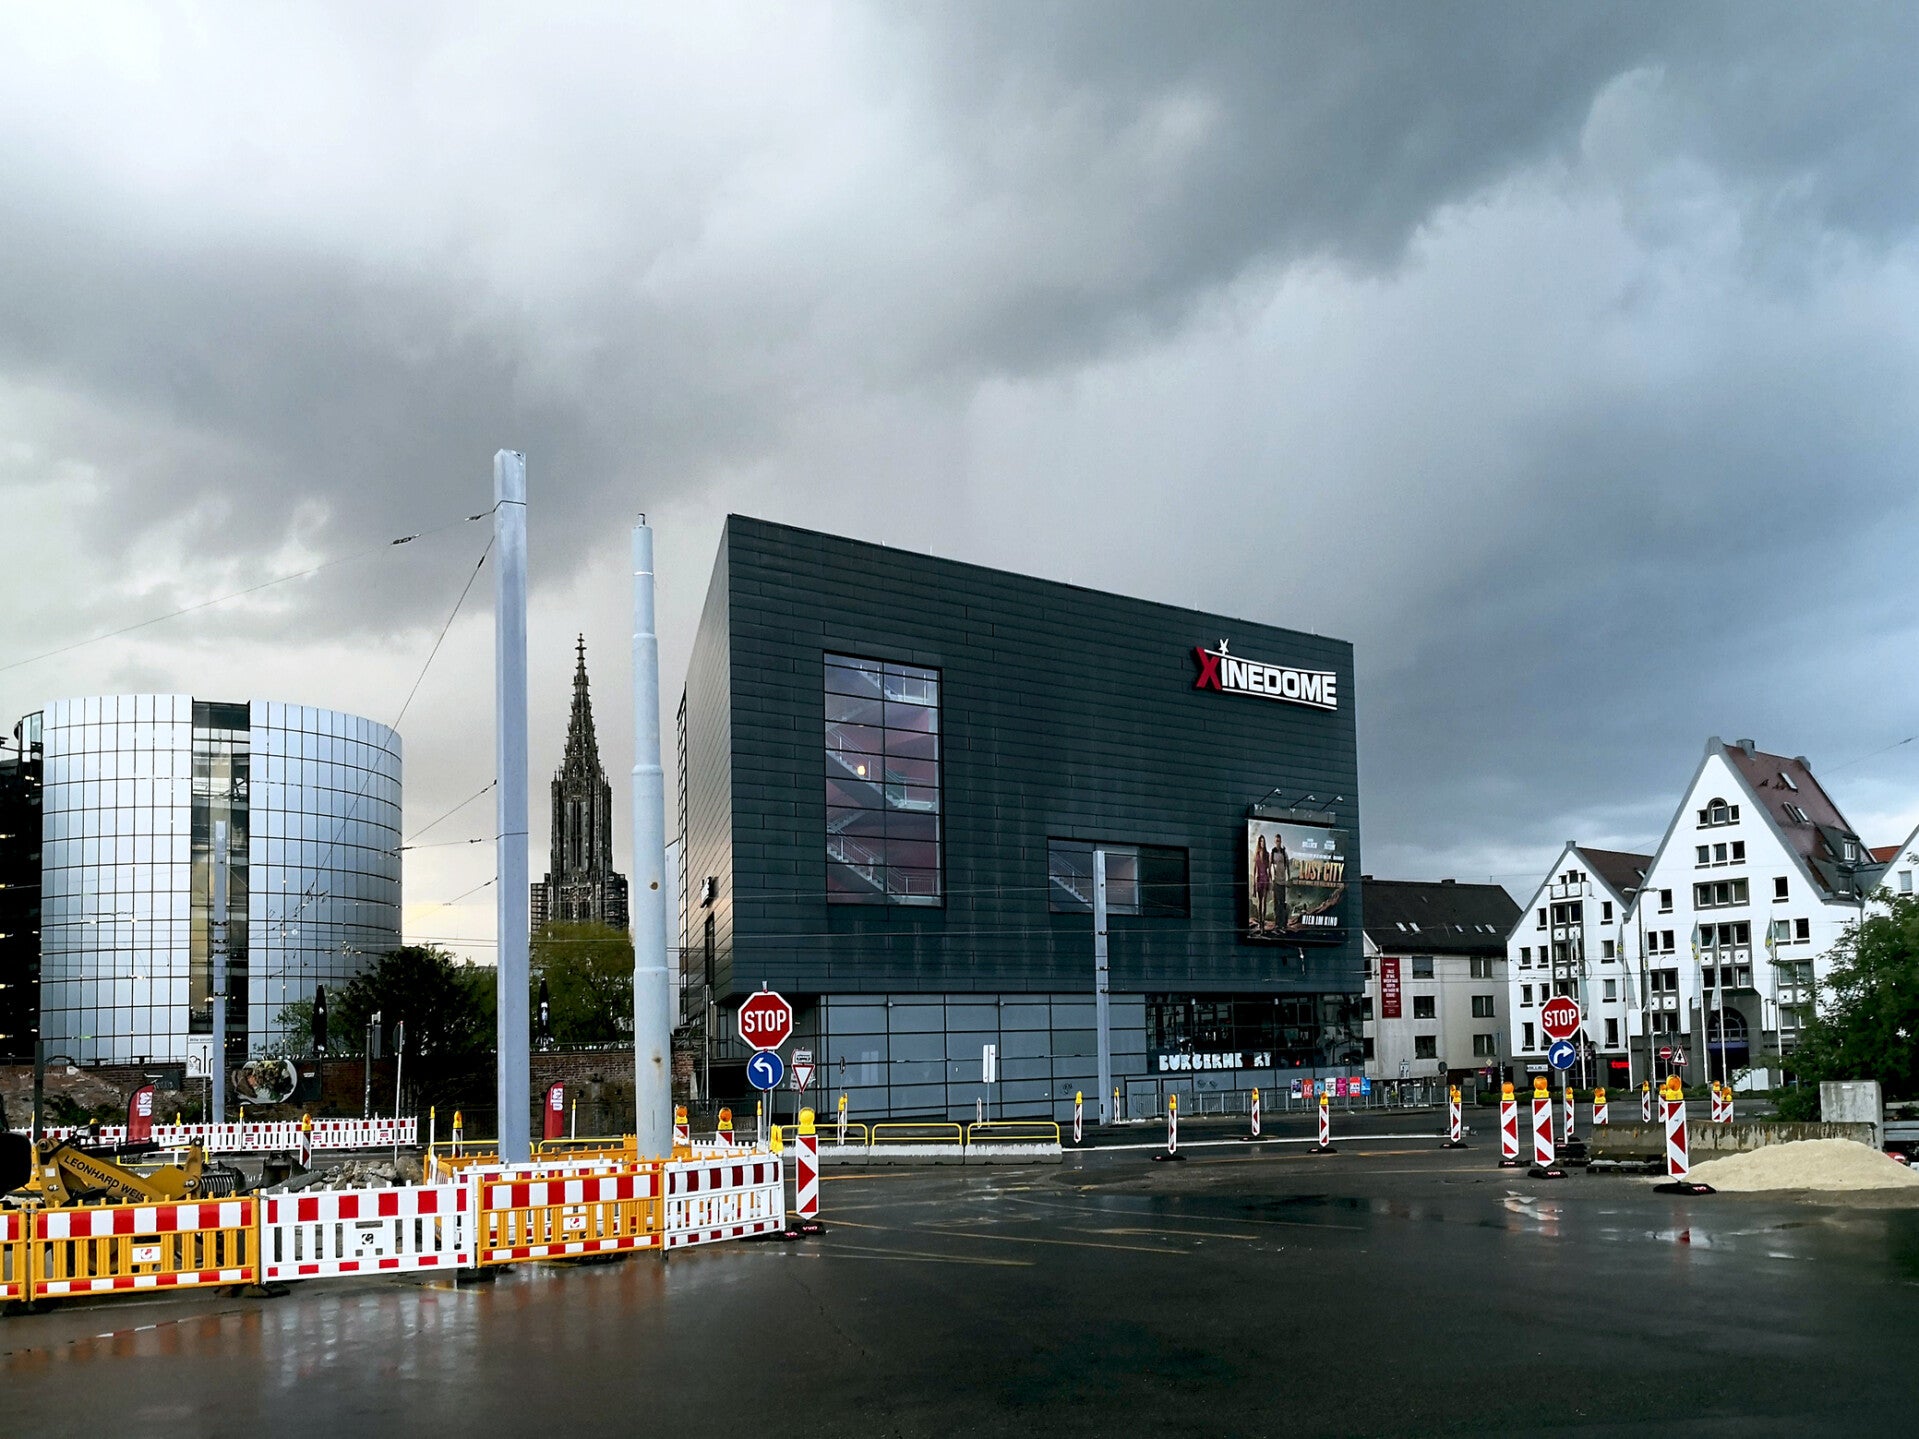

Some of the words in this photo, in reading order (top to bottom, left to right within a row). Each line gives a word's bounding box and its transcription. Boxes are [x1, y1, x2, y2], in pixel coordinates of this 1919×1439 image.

[1196, 646, 1337, 705] XINEDOME
[1324, 862, 1344, 882] CITY
[1324, 916, 1338, 926] KINO
[744, 1009, 787, 1032] STOP
[1544, 1008, 1576, 1028] STOP
[64, 1155, 120, 1188] LEONHARD
[121, 1183, 152, 1202] WEIS
